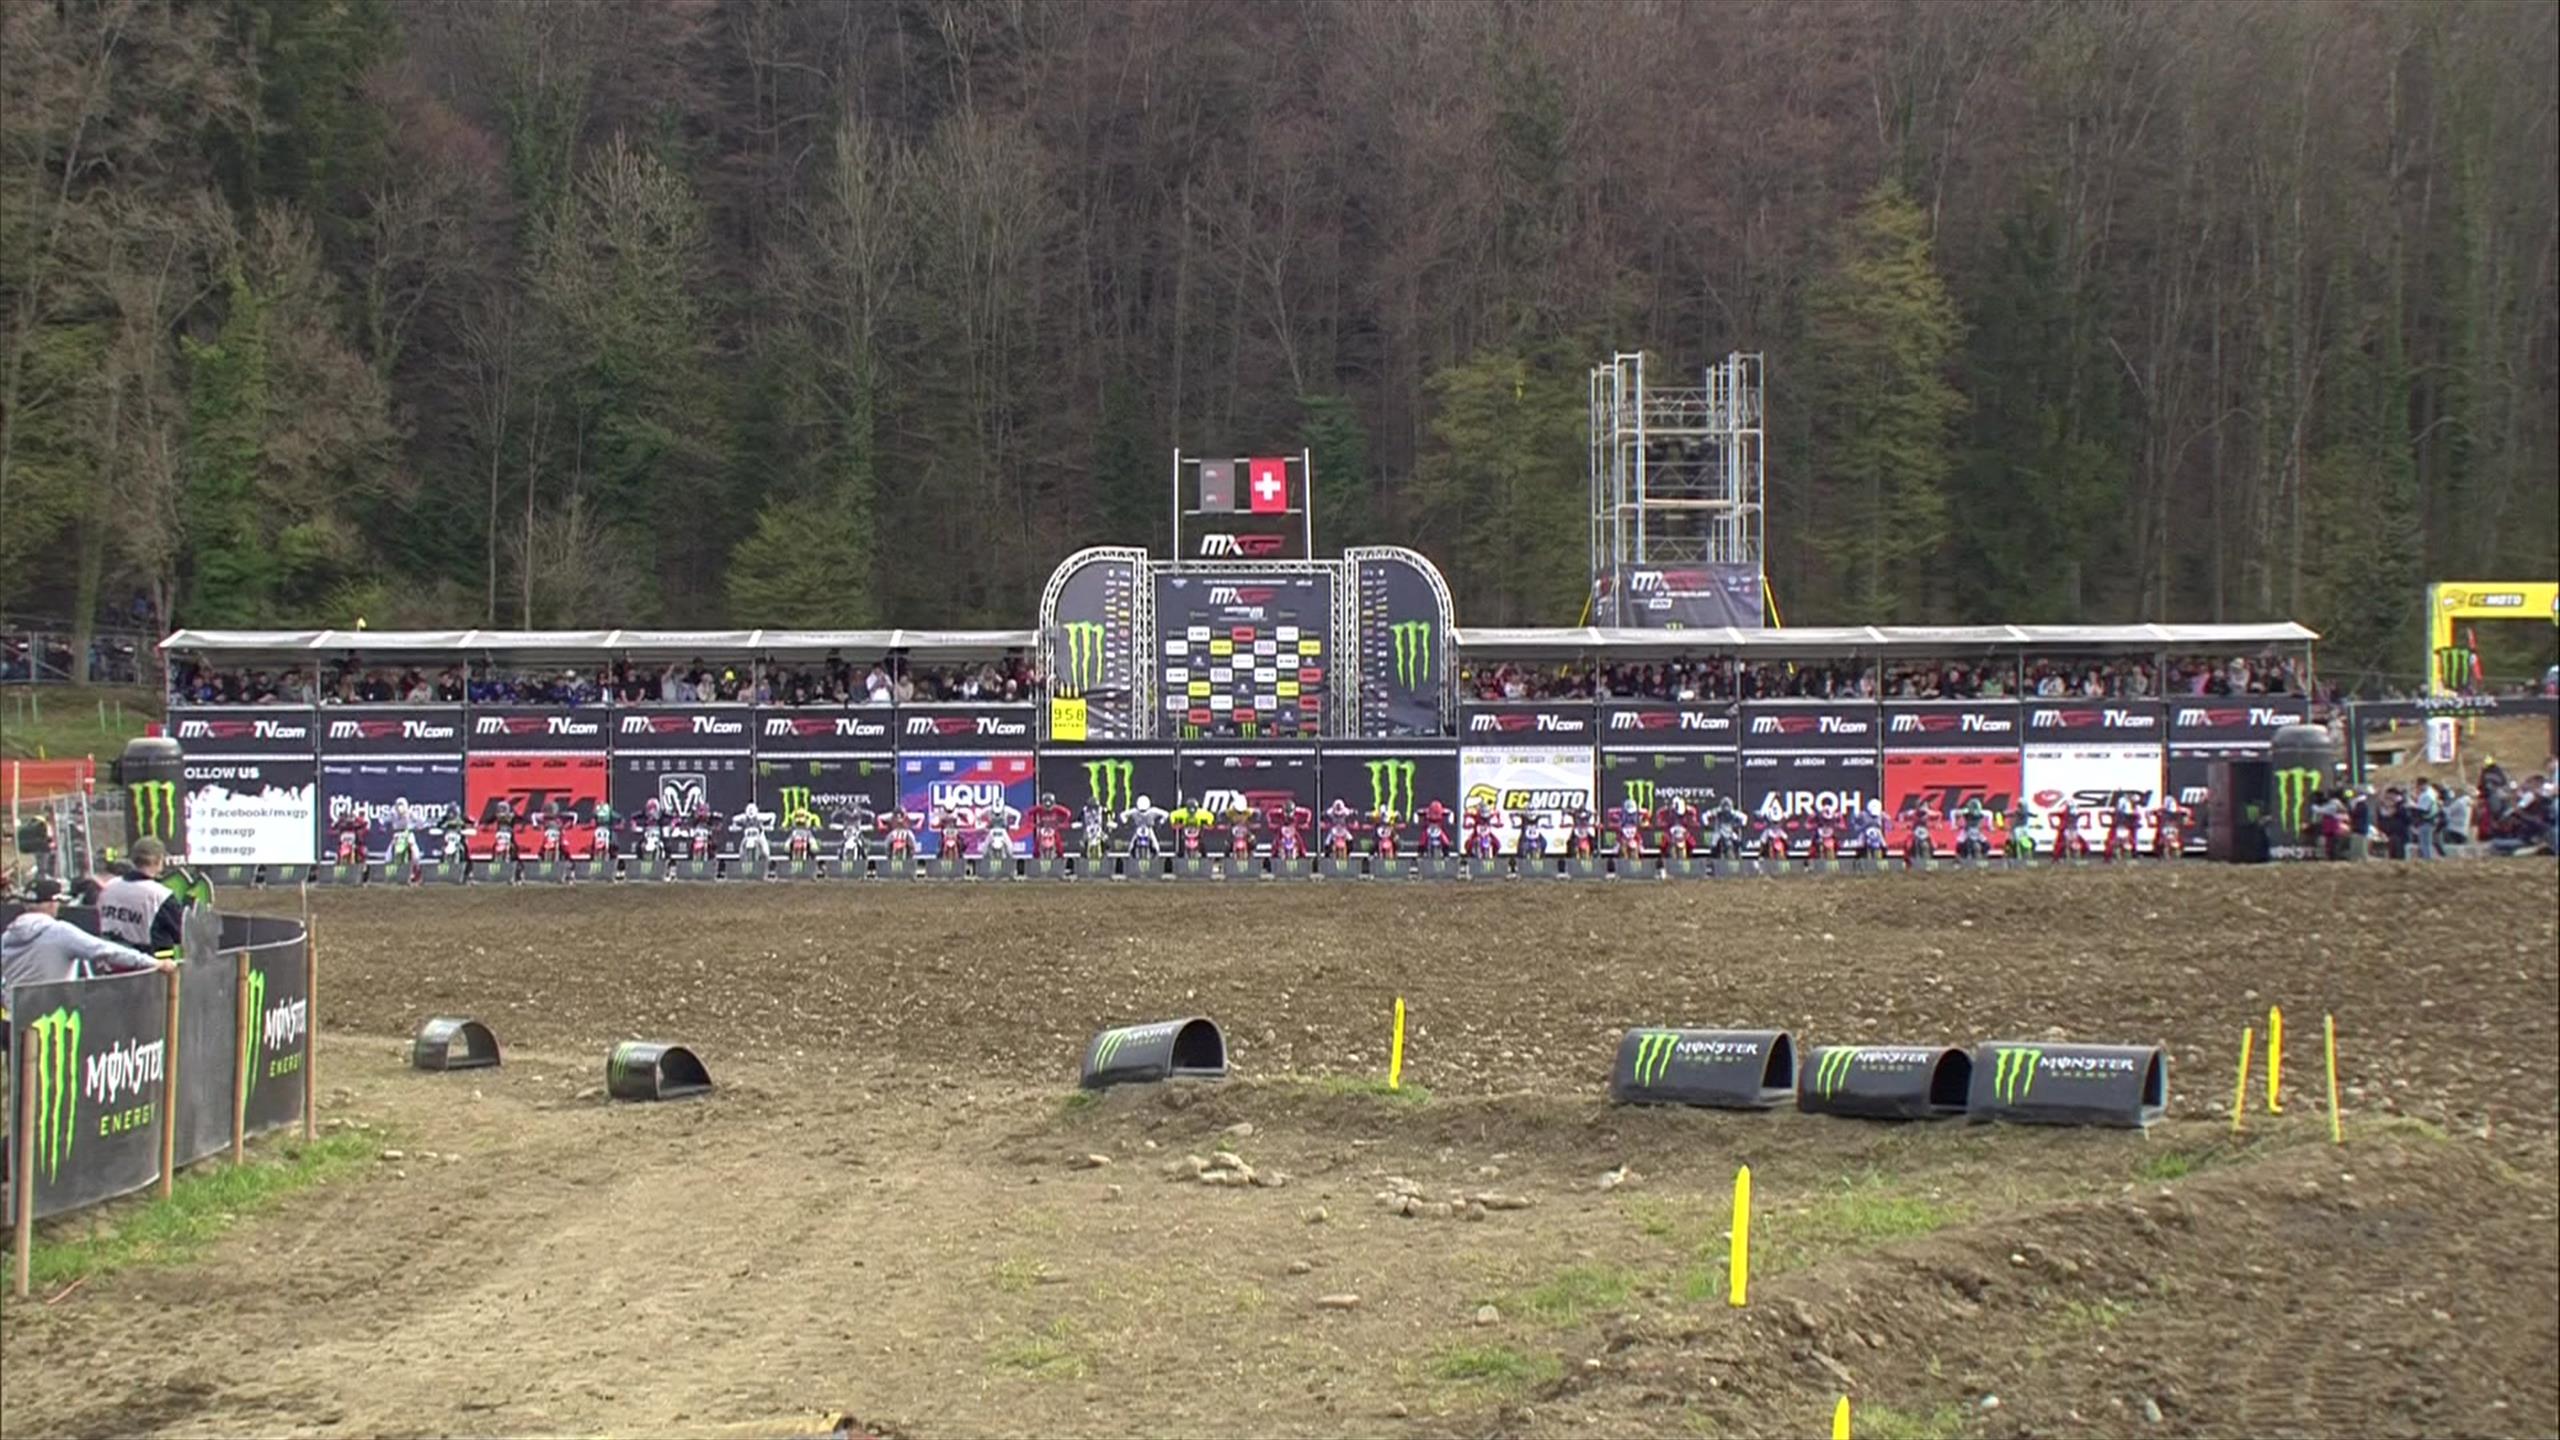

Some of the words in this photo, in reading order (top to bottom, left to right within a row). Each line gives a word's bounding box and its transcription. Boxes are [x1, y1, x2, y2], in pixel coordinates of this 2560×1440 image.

[184, 767, 236, 779] OLLOW
[238, 767, 260, 779] US
[1654, 786, 1716, 798] MONSTER
[810, 792, 871, 805] MONSTER
[210, 827, 256, 838] @mxgp
[1676, 1040, 1758, 1055] MONSTER
[2040, 1056, 2134, 1071] MONSTER
